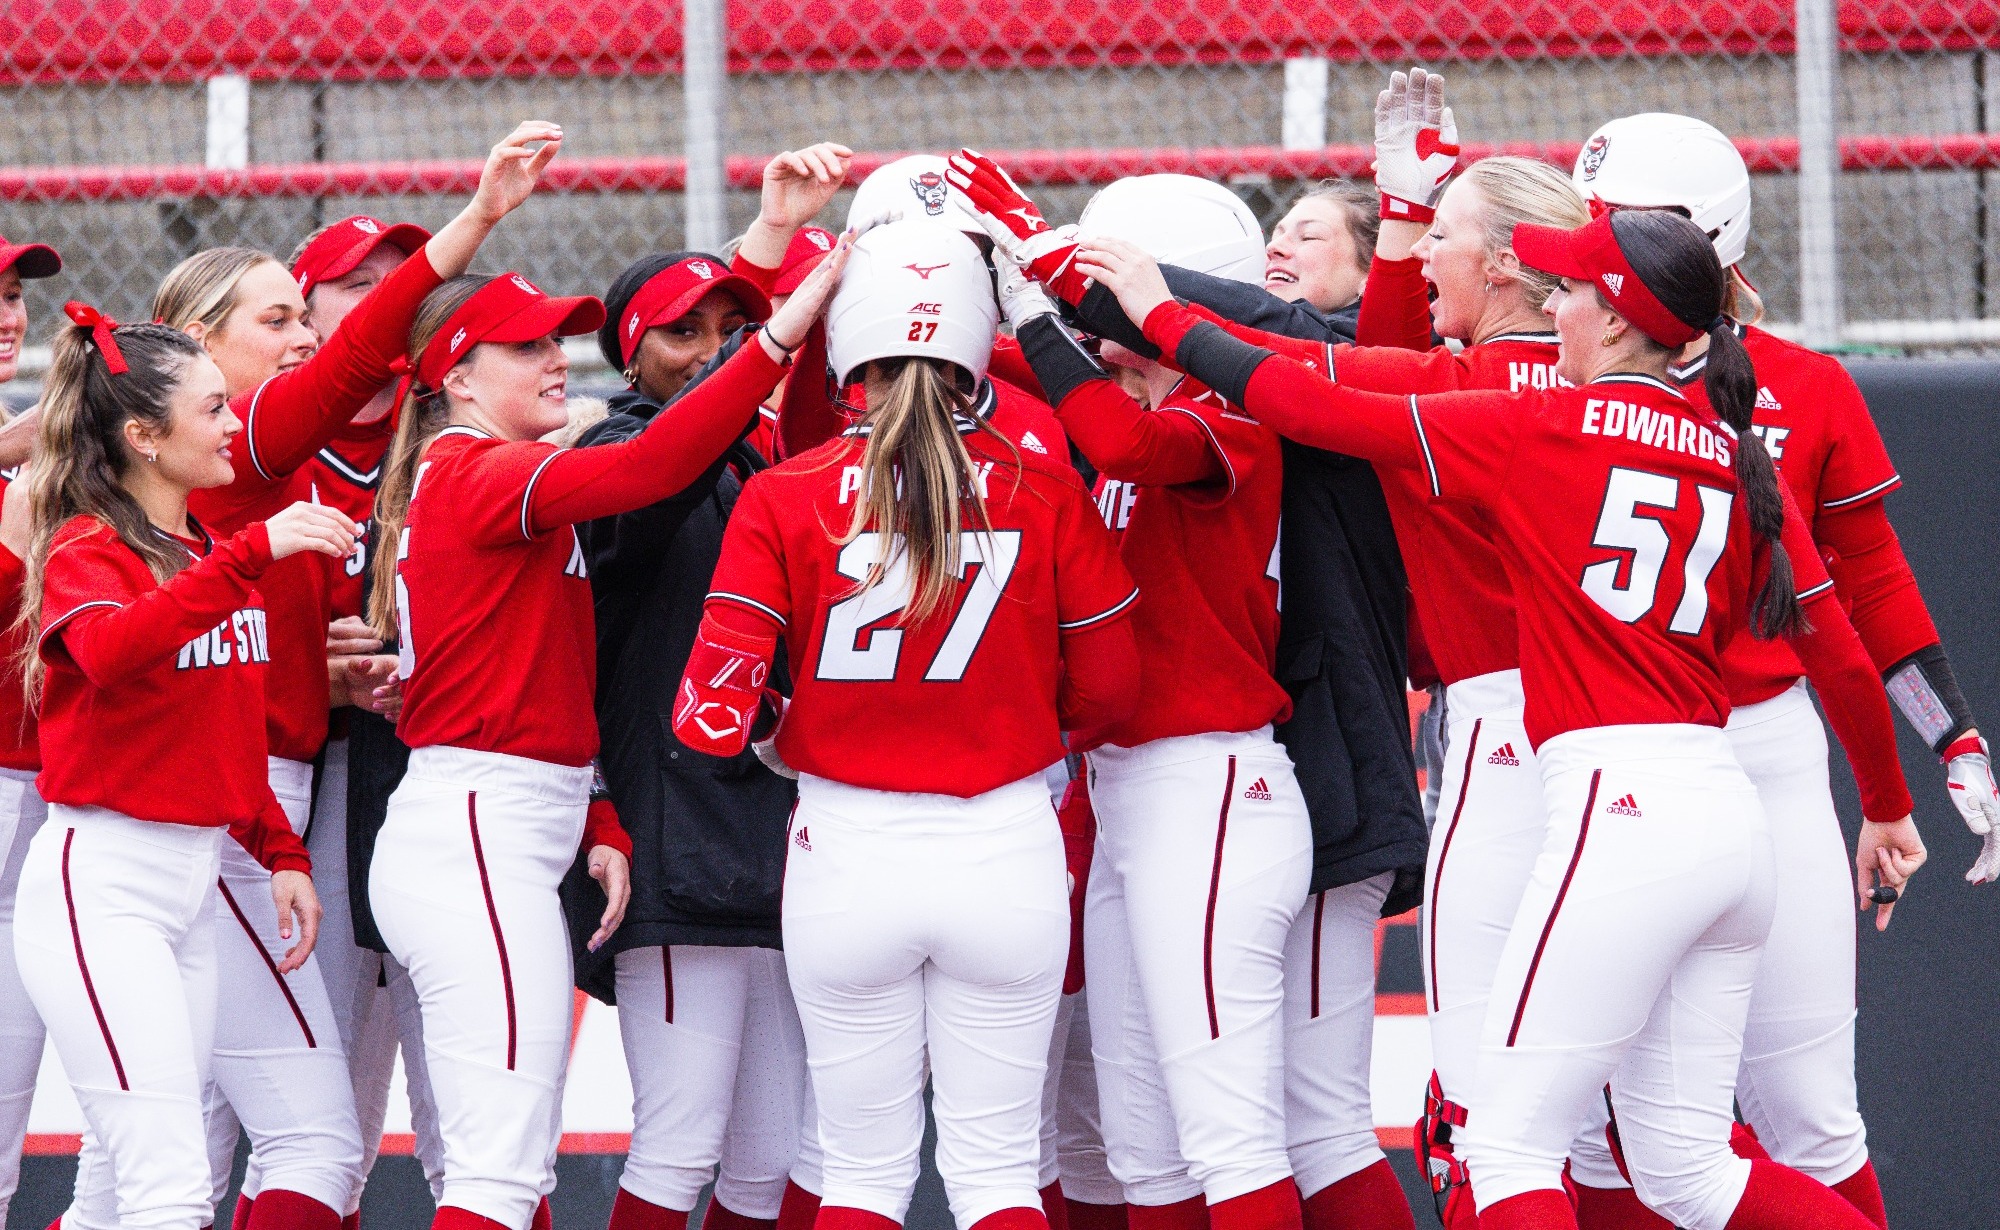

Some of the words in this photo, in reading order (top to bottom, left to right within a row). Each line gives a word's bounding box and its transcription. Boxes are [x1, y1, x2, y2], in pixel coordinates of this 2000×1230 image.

[1601, 273, 1621, 297] adidas
[908, 302, 942, 314] ACC
[450, 326, 467, 354] ACC
[907, 320, 939, 343] 27
[1581, 398, 1731, 468] EDWARDS
[1579, 465, 1736, 637] 51
[814, 529, 1024, 683] 27
[1487, 756, 1520, 767] adidas
[1244, 790, 1272, 801] adidas
[1606, 805, 1642, 818] adidas
